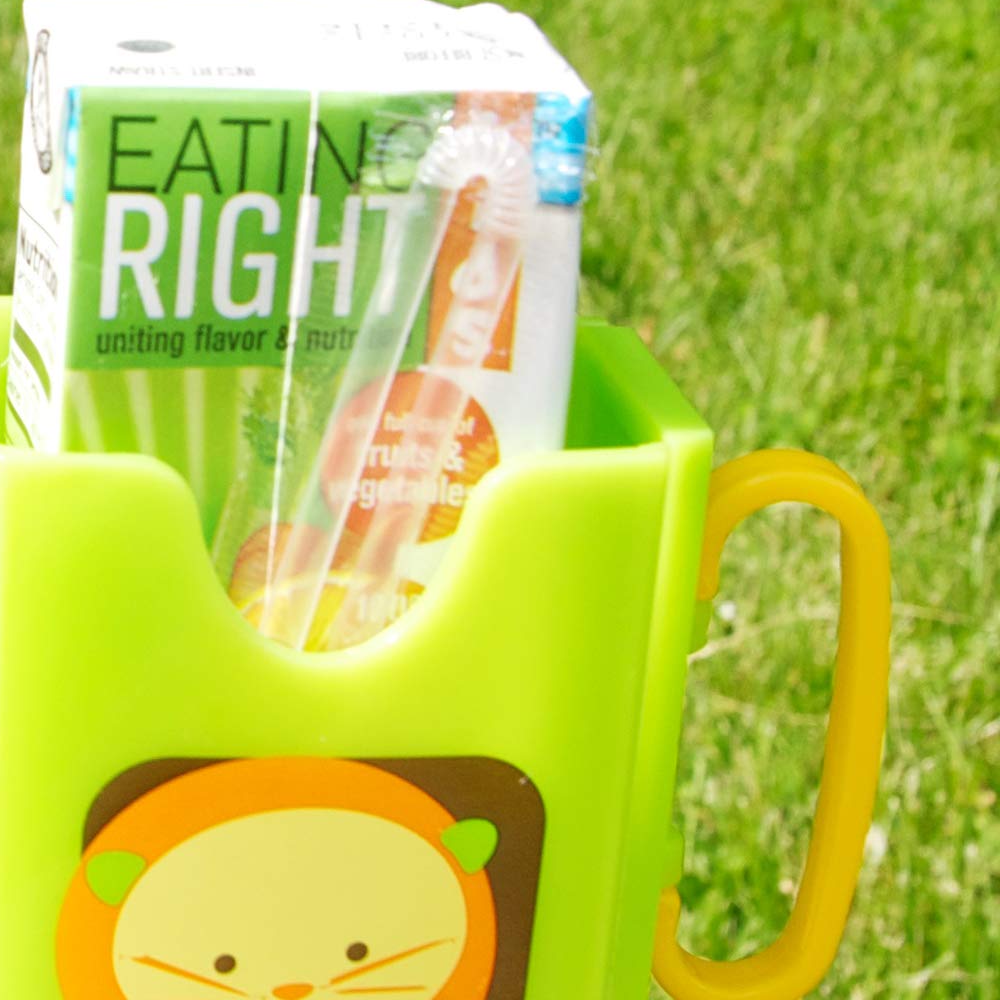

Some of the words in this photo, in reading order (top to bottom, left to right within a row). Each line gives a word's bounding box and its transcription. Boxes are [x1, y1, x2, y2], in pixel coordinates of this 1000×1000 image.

[107, 116, 432, 194] EATING
[100, 191, 427, 320] RIGHT
[96, 325, 184, 357] uniting
[194, 325, 267, 351] flavor
